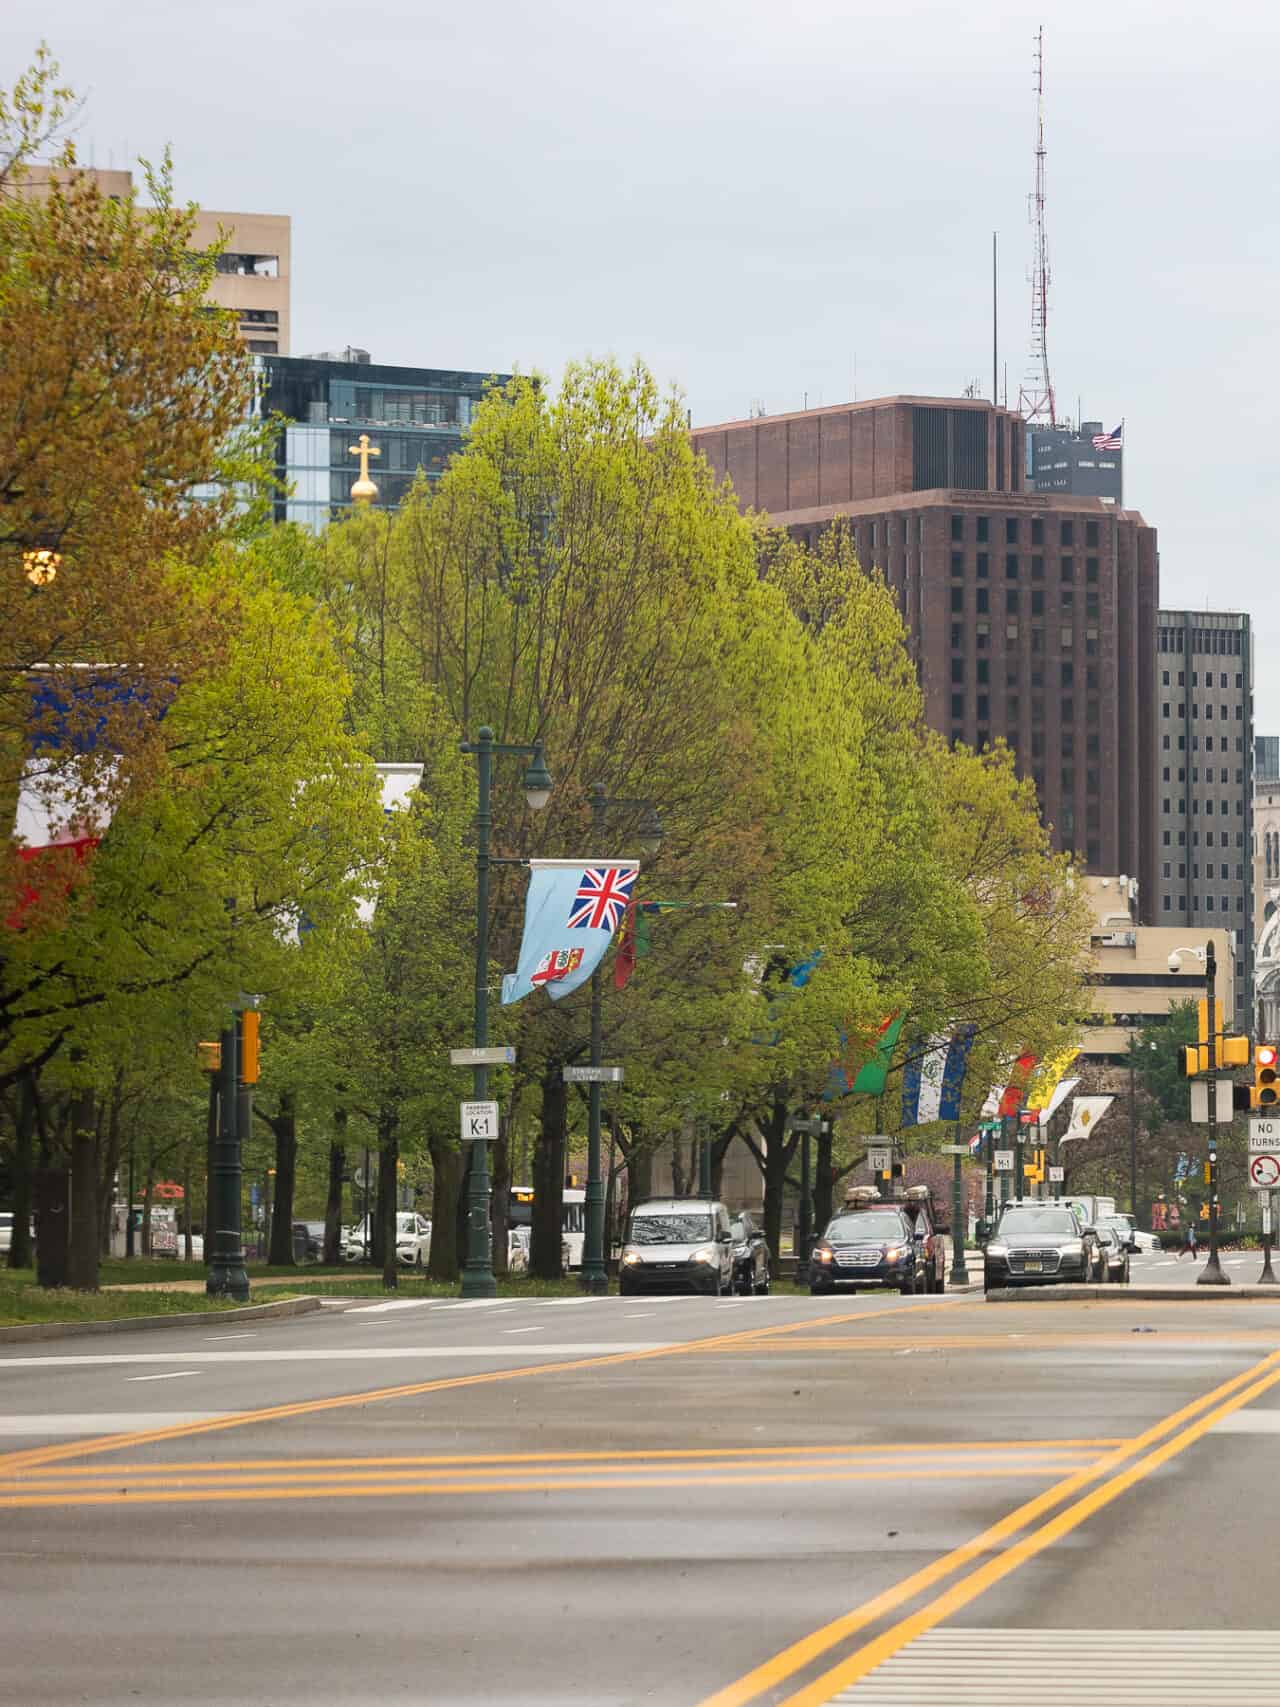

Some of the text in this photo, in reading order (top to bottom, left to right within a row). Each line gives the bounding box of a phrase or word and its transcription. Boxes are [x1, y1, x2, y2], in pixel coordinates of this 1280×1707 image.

[470, 1118, 489, 1135] K-1
[1257, 1123, 1273, 1134] NO
[1251, 1137, 1280, 1147] TURNS
